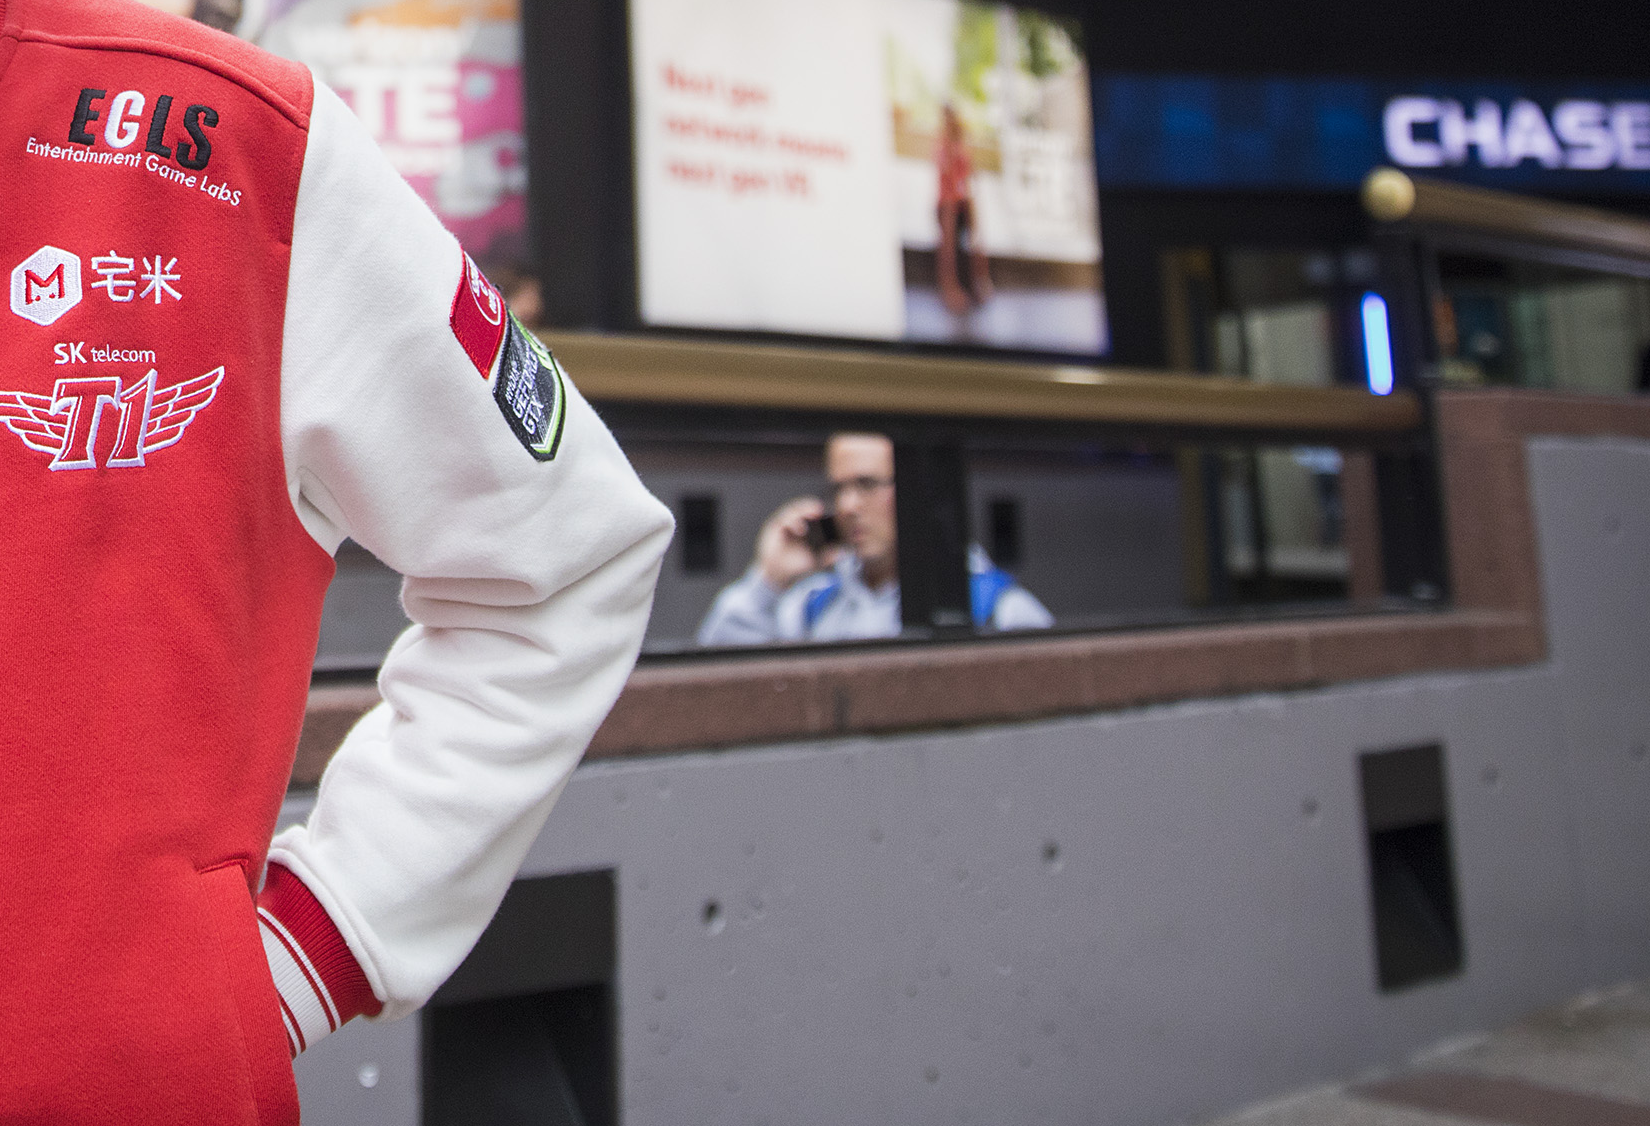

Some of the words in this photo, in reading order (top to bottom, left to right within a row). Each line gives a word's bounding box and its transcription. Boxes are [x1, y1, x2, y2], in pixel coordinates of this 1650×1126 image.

[68, 88, 219, 171] EGLS
[1382, 95, 1650, 171] CHASE
[26, 137, 141, 168] Entertainment
[145, 155, 197, 188] Game
[200, 176, 242, 206] Labs
[91, 250, 183, 304] 宅米
[54, 341, 87, 365] SK
[90, 344, 156, 363] telecom
[522, 394, 545, 435] GTX
